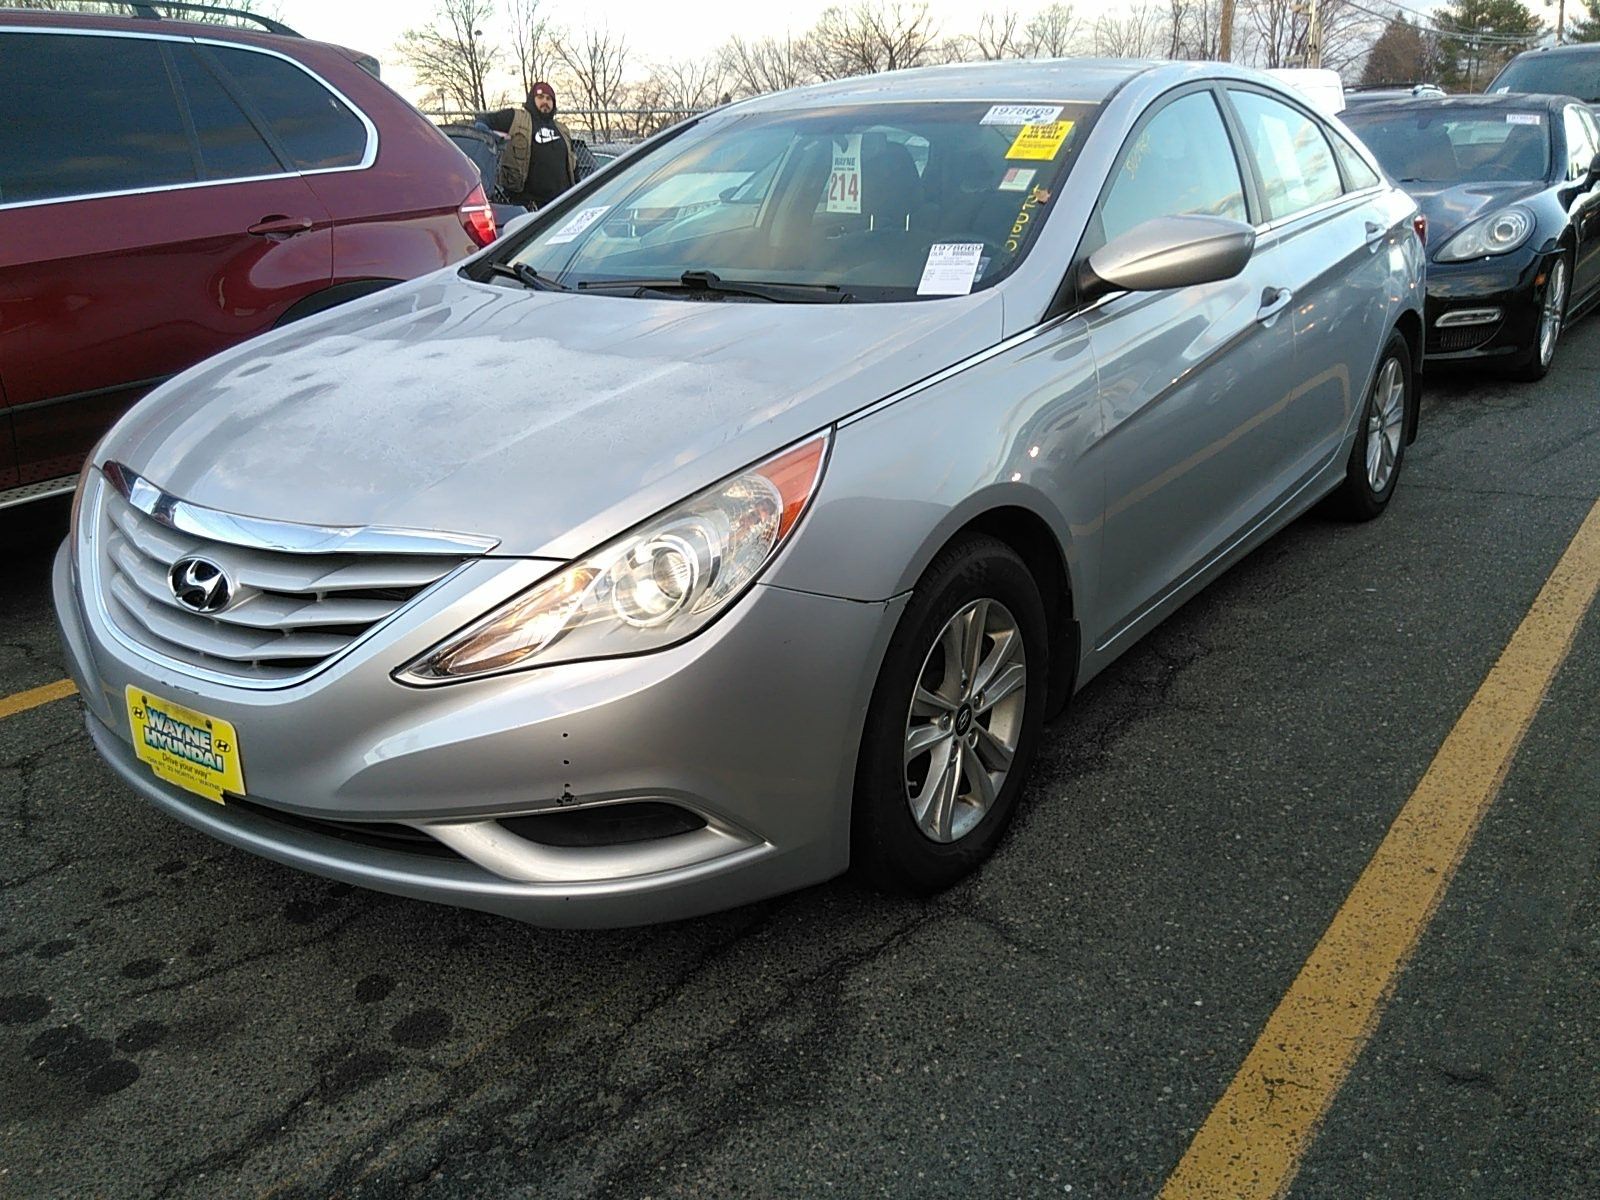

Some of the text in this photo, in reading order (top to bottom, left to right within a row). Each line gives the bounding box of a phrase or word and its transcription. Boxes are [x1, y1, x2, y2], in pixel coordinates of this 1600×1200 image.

[992, 107, 1054, 115] 1978669
[835, 158, 856, 166] WAYNE
[830, 173, 858, 202] 214
[145, 705, 212, 751] WAYNE
[143, 725, 224, 774] HYUNDAI
[162, 752, 179, 767] Drive
[179, 762, 195, 773] your
